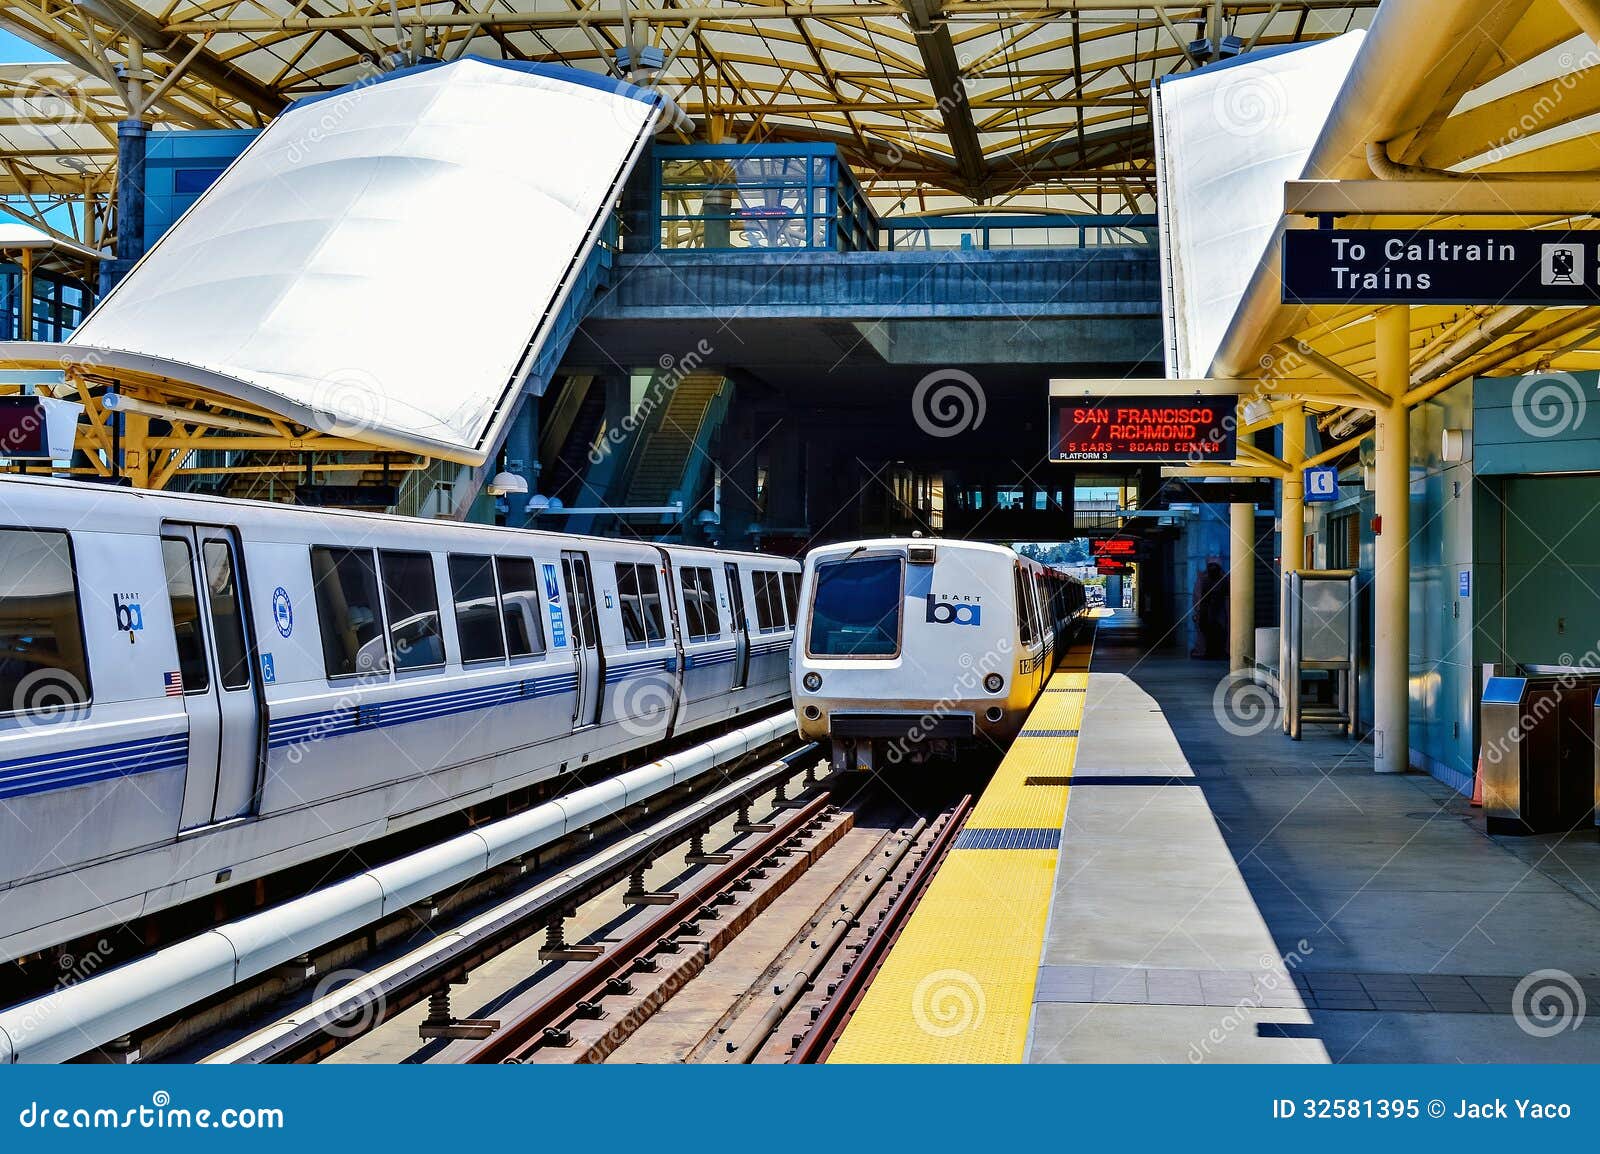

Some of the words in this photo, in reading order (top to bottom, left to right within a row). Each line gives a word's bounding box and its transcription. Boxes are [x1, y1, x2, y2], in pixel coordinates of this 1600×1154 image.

[1332, 238, 1366, 261] To
[1384, 238, 1515, 261] Caltrain
[1332, 267, 1431, 290] Trains
[1073, 409, 1109, 424] SAN
[1116, 409, 1213, 424] FRANCISCO
[1109, 425, 1196, 440] RICHMOND
[1068, 442, 1077, 453] 5
[1080, 442, 1113, 453] CARS
[1129, 442, 1169, 453] BOARD
[1174, 442, 1220, 453] CENTER
[1059, 452, 1100, 460] PLATFORM
[1102, 452, 1108, 460] 3
[941, 594, 981, 602] BART
